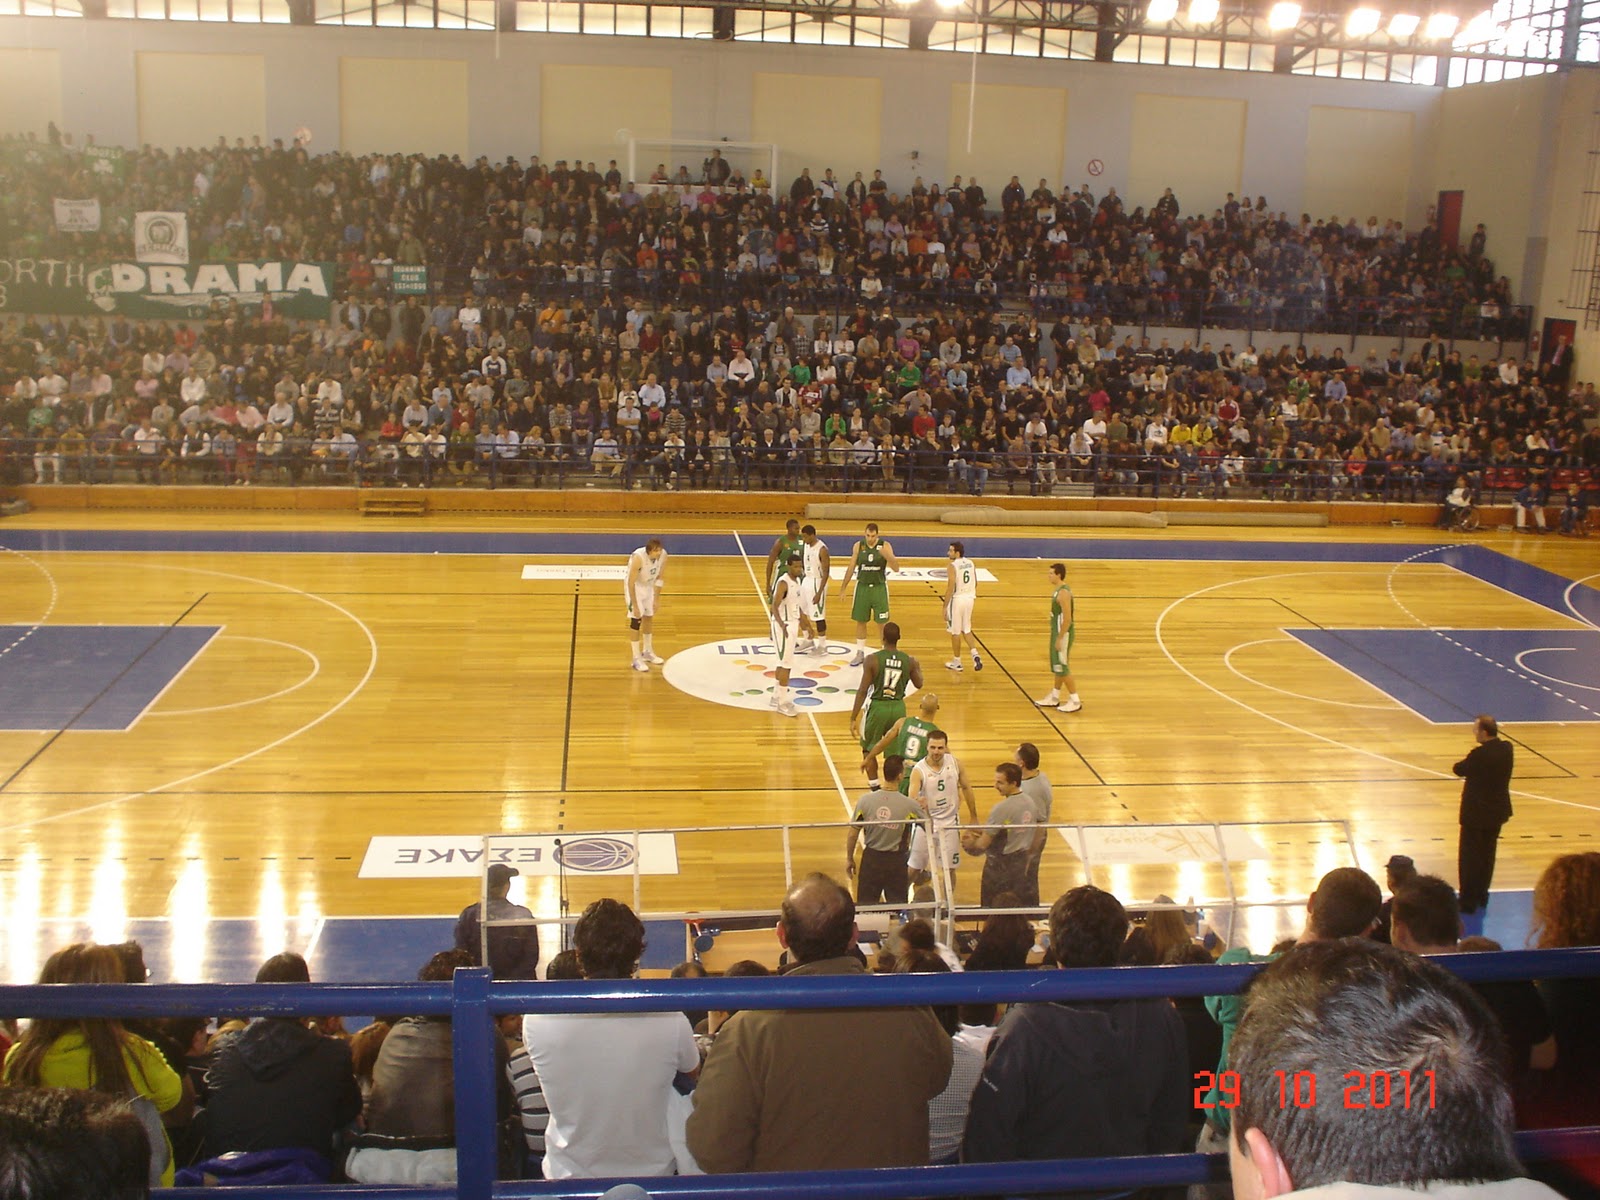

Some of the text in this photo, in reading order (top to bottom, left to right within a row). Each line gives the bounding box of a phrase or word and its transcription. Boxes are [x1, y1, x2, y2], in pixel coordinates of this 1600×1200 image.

[111, 261, 329, 298] DRAMA
[963, 570, 970, 584] 6
[884, 668, 902, 688] 17
[905, 735, 921, 759] 9
[937, 779, 945, 792] 5
[952, 853, 960, 865] 5
